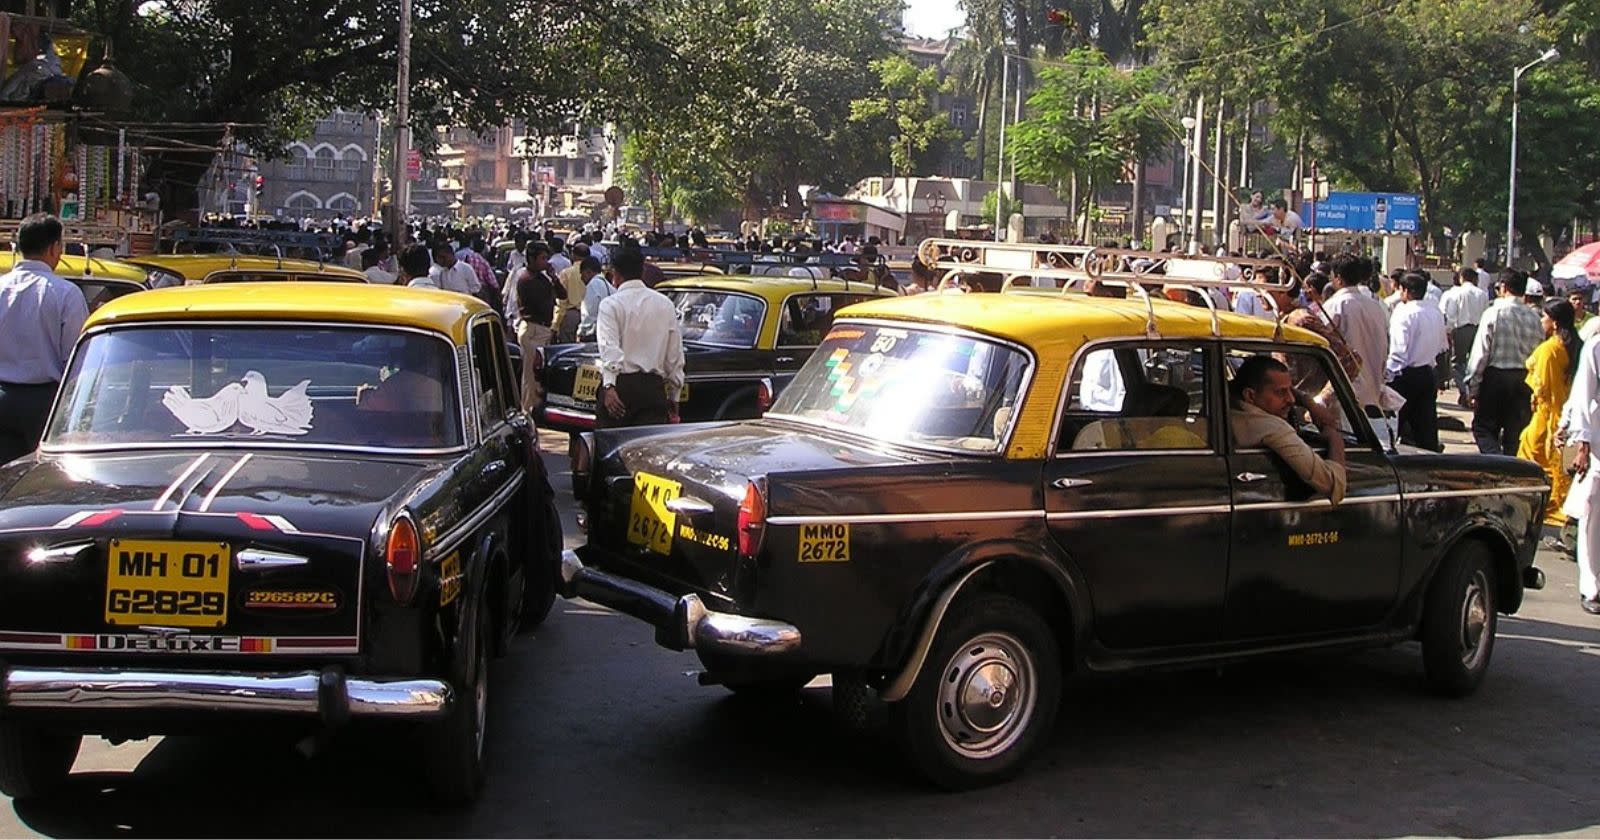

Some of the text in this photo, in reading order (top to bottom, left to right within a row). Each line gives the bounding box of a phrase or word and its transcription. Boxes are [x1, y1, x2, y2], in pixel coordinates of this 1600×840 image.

[1316, 202, 1330, 211] One
[1330, 202, 1349, 211] touch
[1350, 203, 1360, 213] key
[1361, 204, 1369, 212] to
[1316, 210, 1346, 219] FM Radio
[581, 368, 595, 379] MH
[632, 513, 669, 544] 2672
[802, 541, 846, 560] 2672
[118, 551, 219, 578] MH 01
[108, 589, 226, 616] G2829
